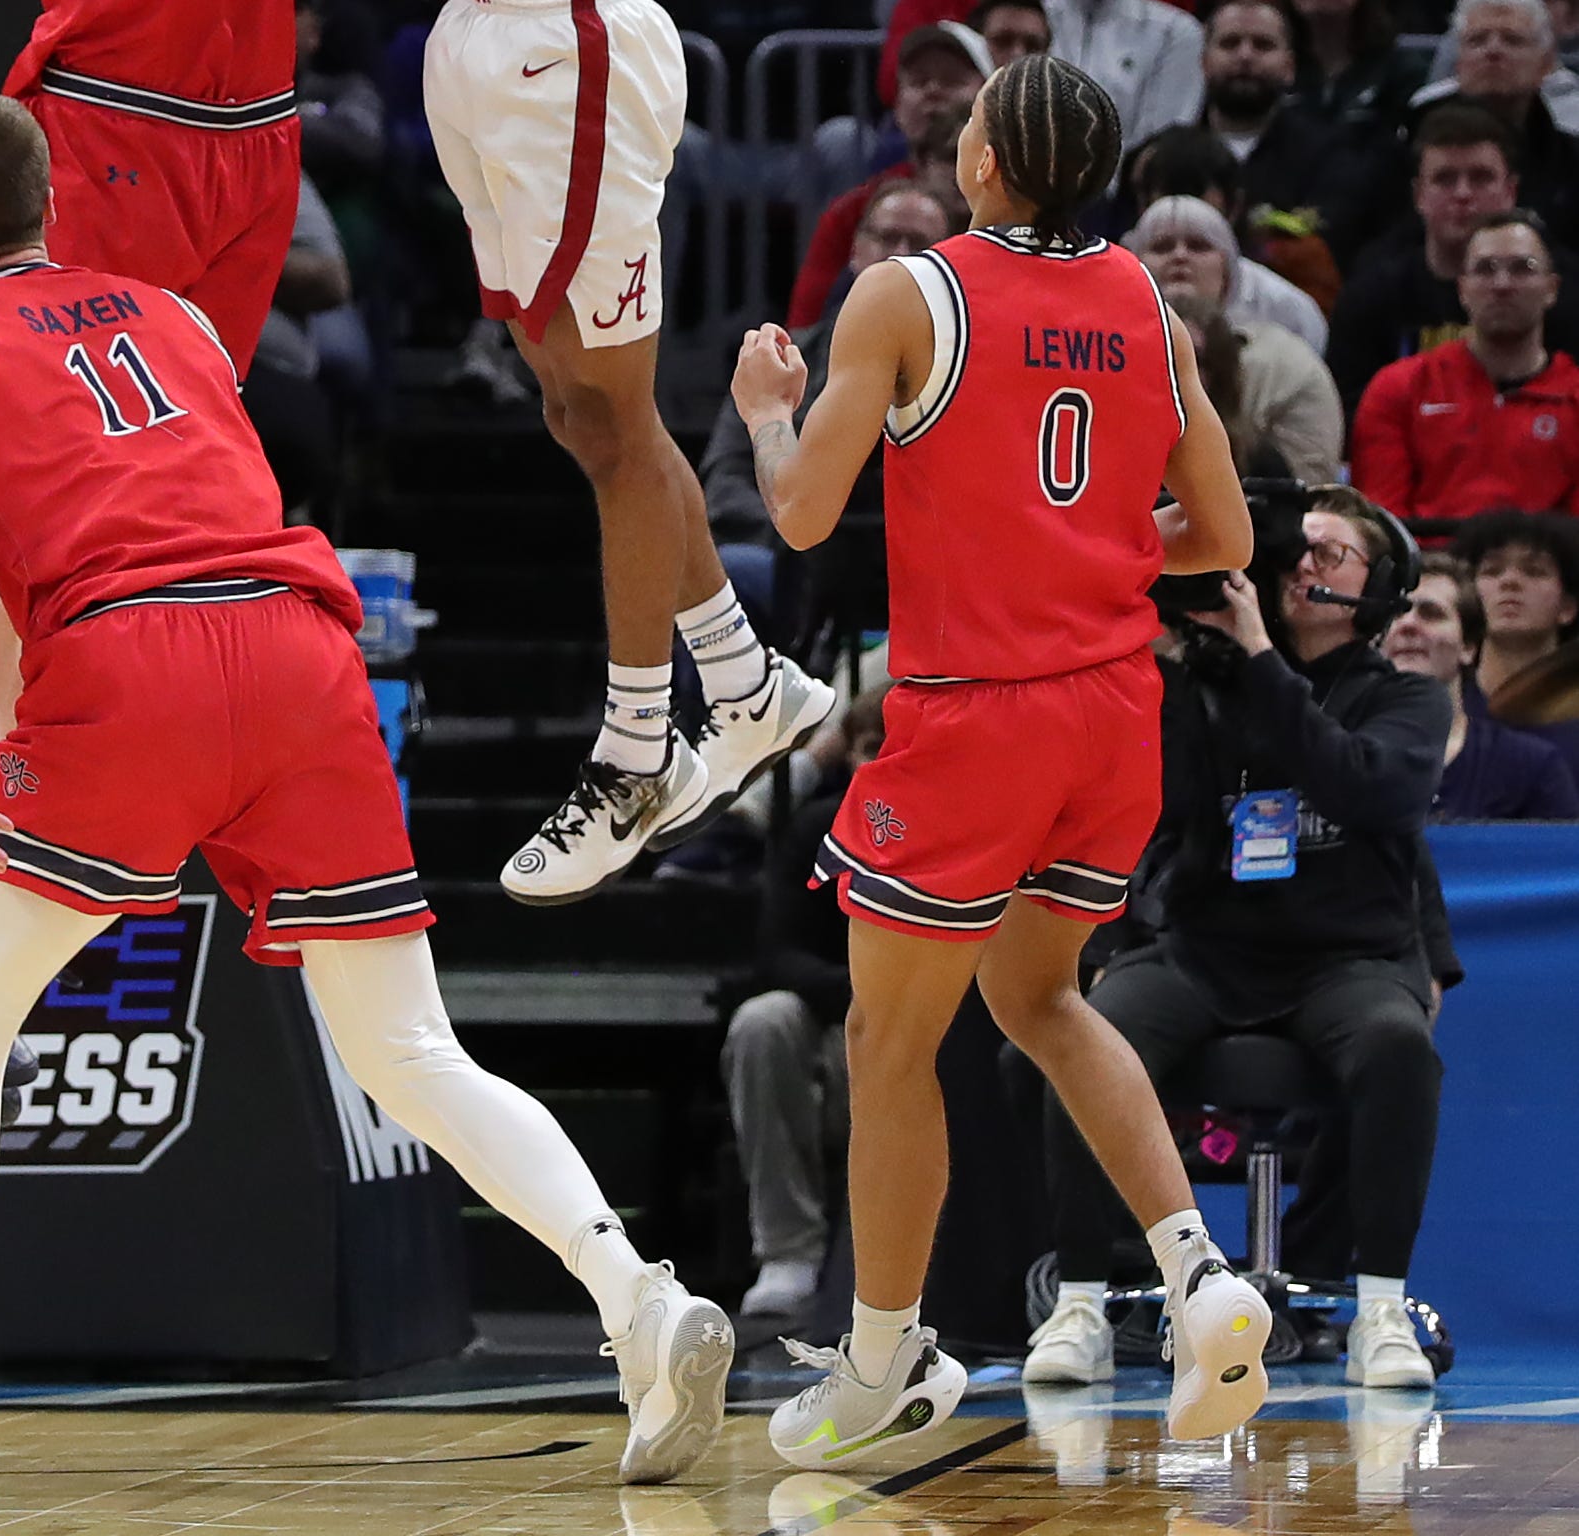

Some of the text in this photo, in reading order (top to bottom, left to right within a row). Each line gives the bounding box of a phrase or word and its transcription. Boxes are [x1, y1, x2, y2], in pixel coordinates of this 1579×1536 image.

[18, 291, 143, 335] SAXEN
[1024, 326, 1125, 372] LEWIS
[64, 332, 189, 436] 11
[1038, 387, 1094, 506] 0
